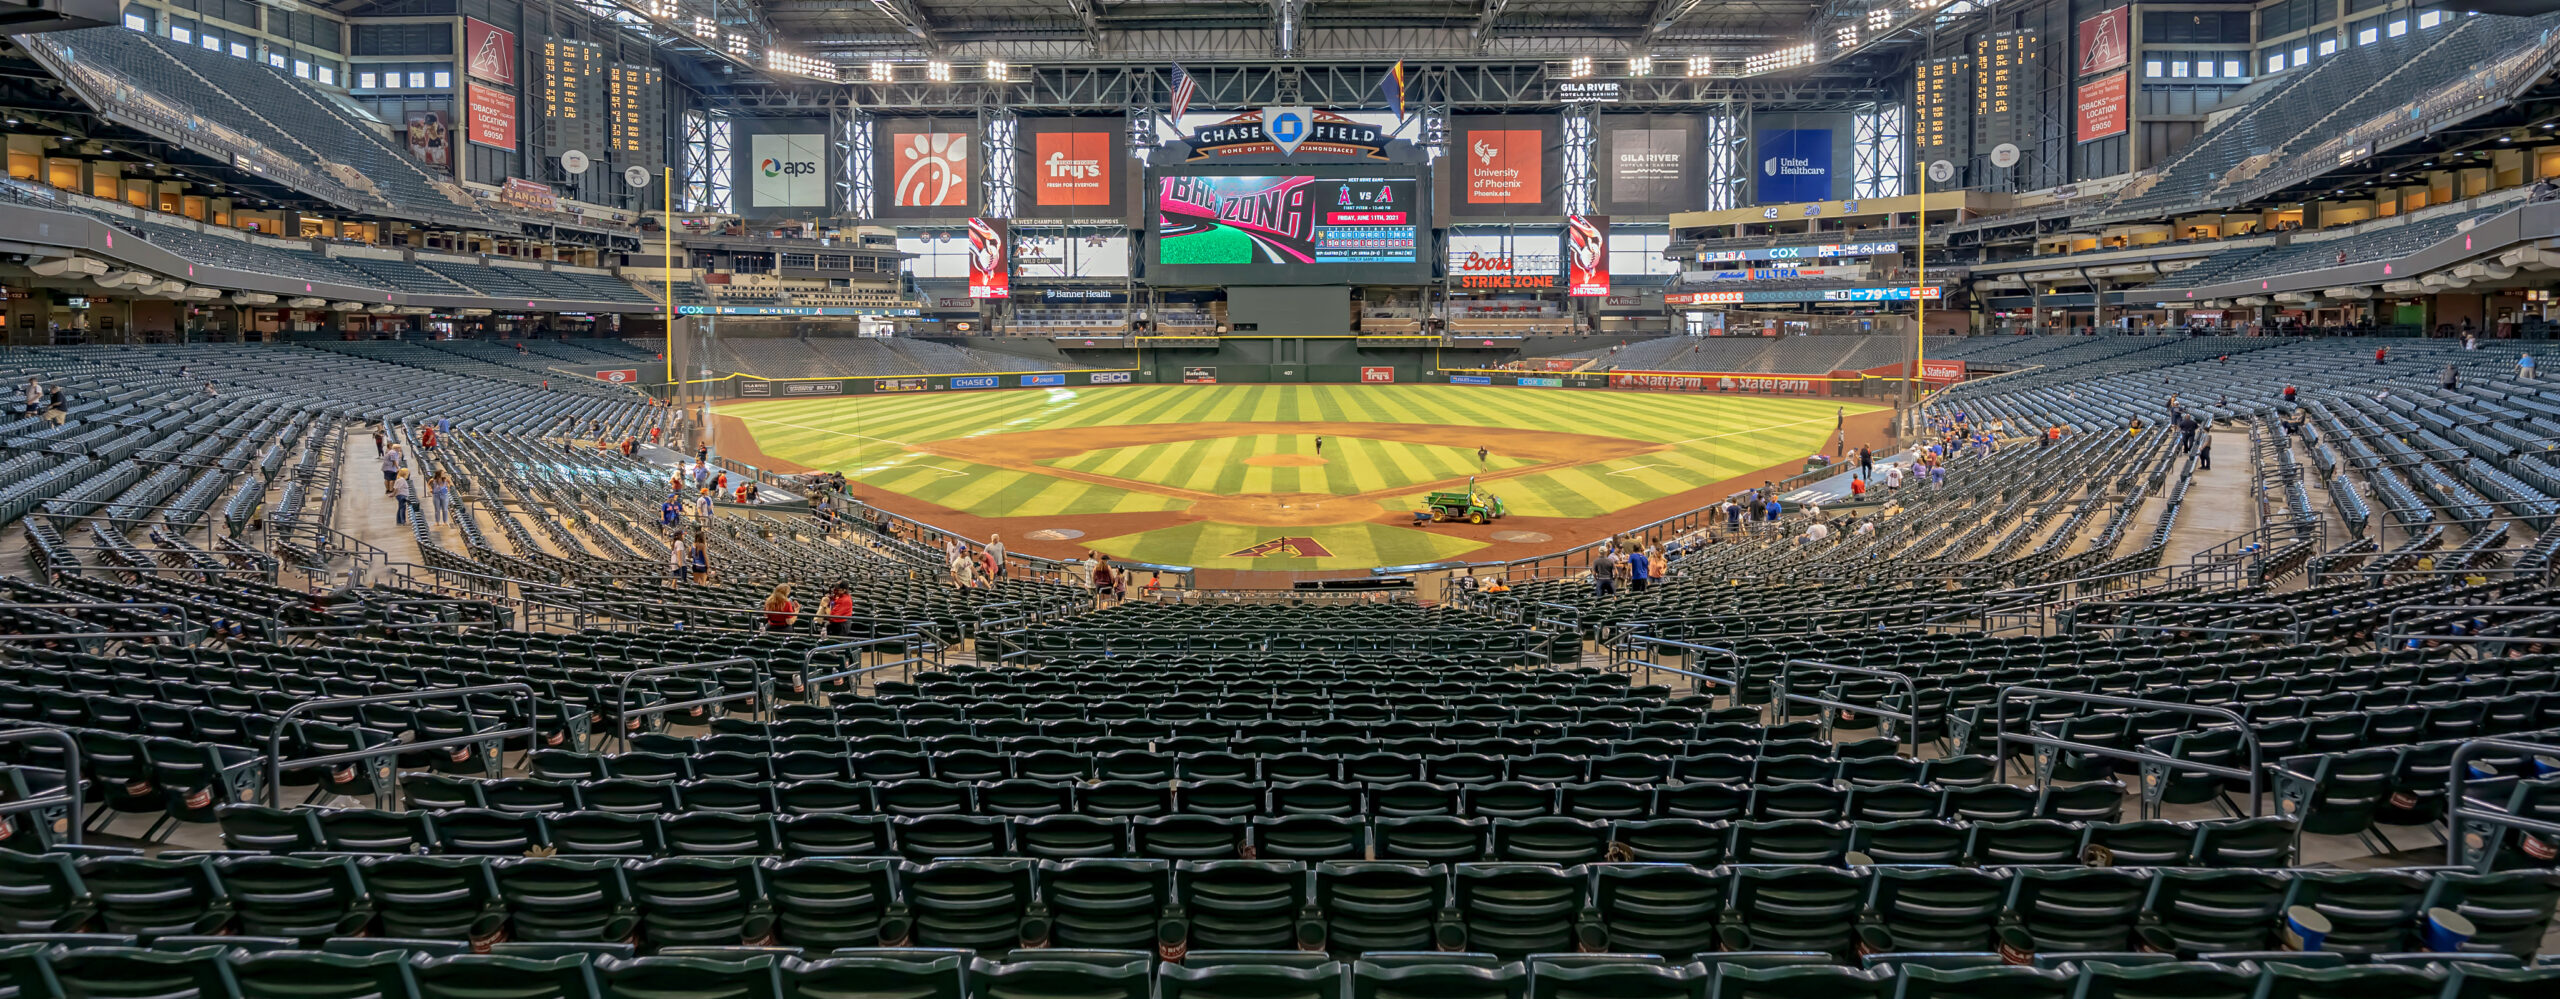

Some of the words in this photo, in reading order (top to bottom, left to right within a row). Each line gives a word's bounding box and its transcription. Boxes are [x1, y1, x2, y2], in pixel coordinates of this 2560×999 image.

[1560, 83, 1586, 91] GILA
[1587, 83, 1618, 91] RIVER
[2086, 104, 2117, 119] LOCATION
[479, 114, 508, 127] LOCATION
[2091, 120, 2112, 132] 69050
[484, 129, 503, 141] 69050
[1200, 126, 1260, 143] CHASE
[1316, 126, 1375, 142] FIELD
[1300, 146, 1354, 154] DIAMONDBACKS
[1620, 154, 1645, 162] GILA
[1646, 154, 1679, 162] RIVER
[1780, 158, 1809, 167] United
[783, 161, 816, 178] aps
[1044, 151, 1100, 179] fry's
[1474, 168, 1519, 179] University
[1780, 166, 1825, 175] Healthcare
[1474, 179, 1485, 188] of
[1485, 179, 1521, 188] Phoenix
[507, 189, 553, 205] SANDLOT
[1359, 191, 1372, 200] VS
[1804, 204, 1820, 216] 20
[1843, 200, 1858, 213] 51
[1763, 207, 1778, 219] 42
[1876, 243, 1896, 252] 4:03
[1769, 248, 1799, 258] COX
[1462, 251, 1514, 271] Coors
[1755, 269, 1799, 279] ULTRA
[1462, 276, 1511, 288] STRIKE
[1513, 276, 1554, 288] ZONE
[1056, 290, 1084, 298] Banner
[1086, 290, 1111, 298] Health
[680, 306, 704, 314] COX
[1091, 373, 1130, 382] GEICO
[1365, 368, 1390, 381] fry's
[956, 378, 985, 387] CHASE
[1039, 376, 1054, 384] pepsi
[1464, 581, 1473, 589] 31
